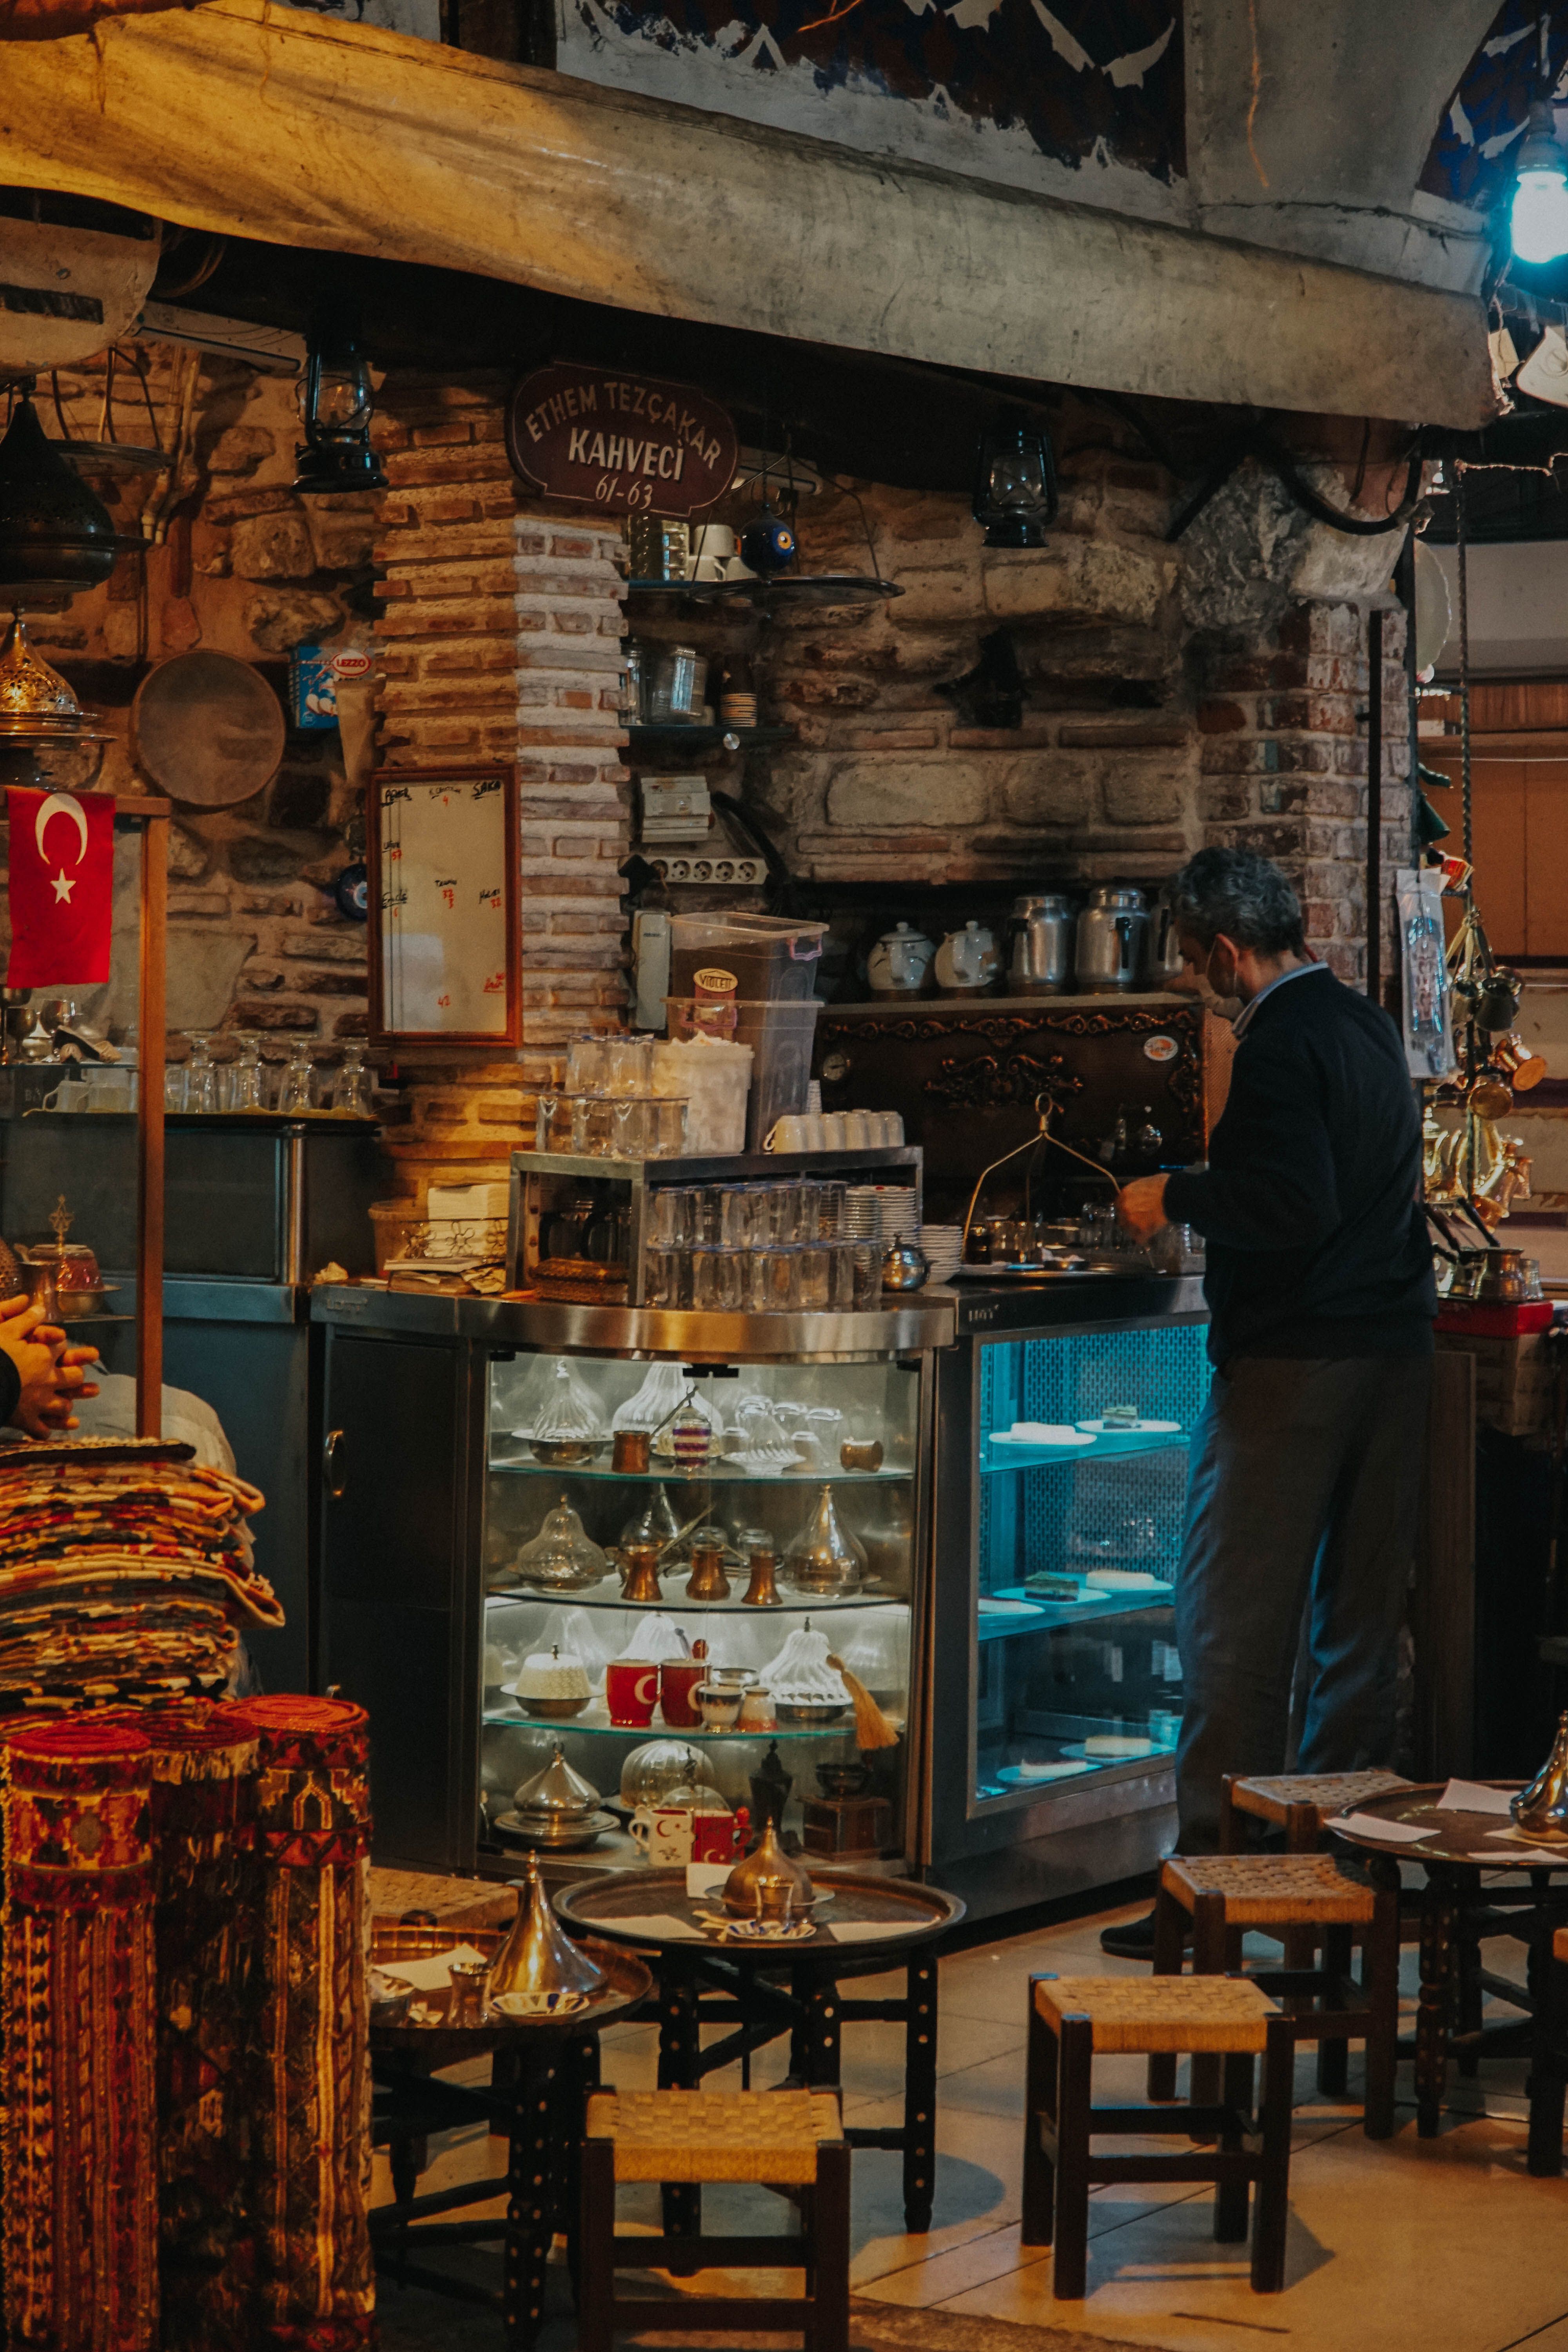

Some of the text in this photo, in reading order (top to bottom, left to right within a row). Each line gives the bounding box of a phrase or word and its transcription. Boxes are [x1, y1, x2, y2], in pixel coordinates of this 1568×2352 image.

[525, 382, 721, 470] ETHEM TEZÇAKAR
[568, 427, 684, 481] KAHVECİ
[595, 474, 653, 510] 61-63
[336, 659, 366, 667] LEZZO
